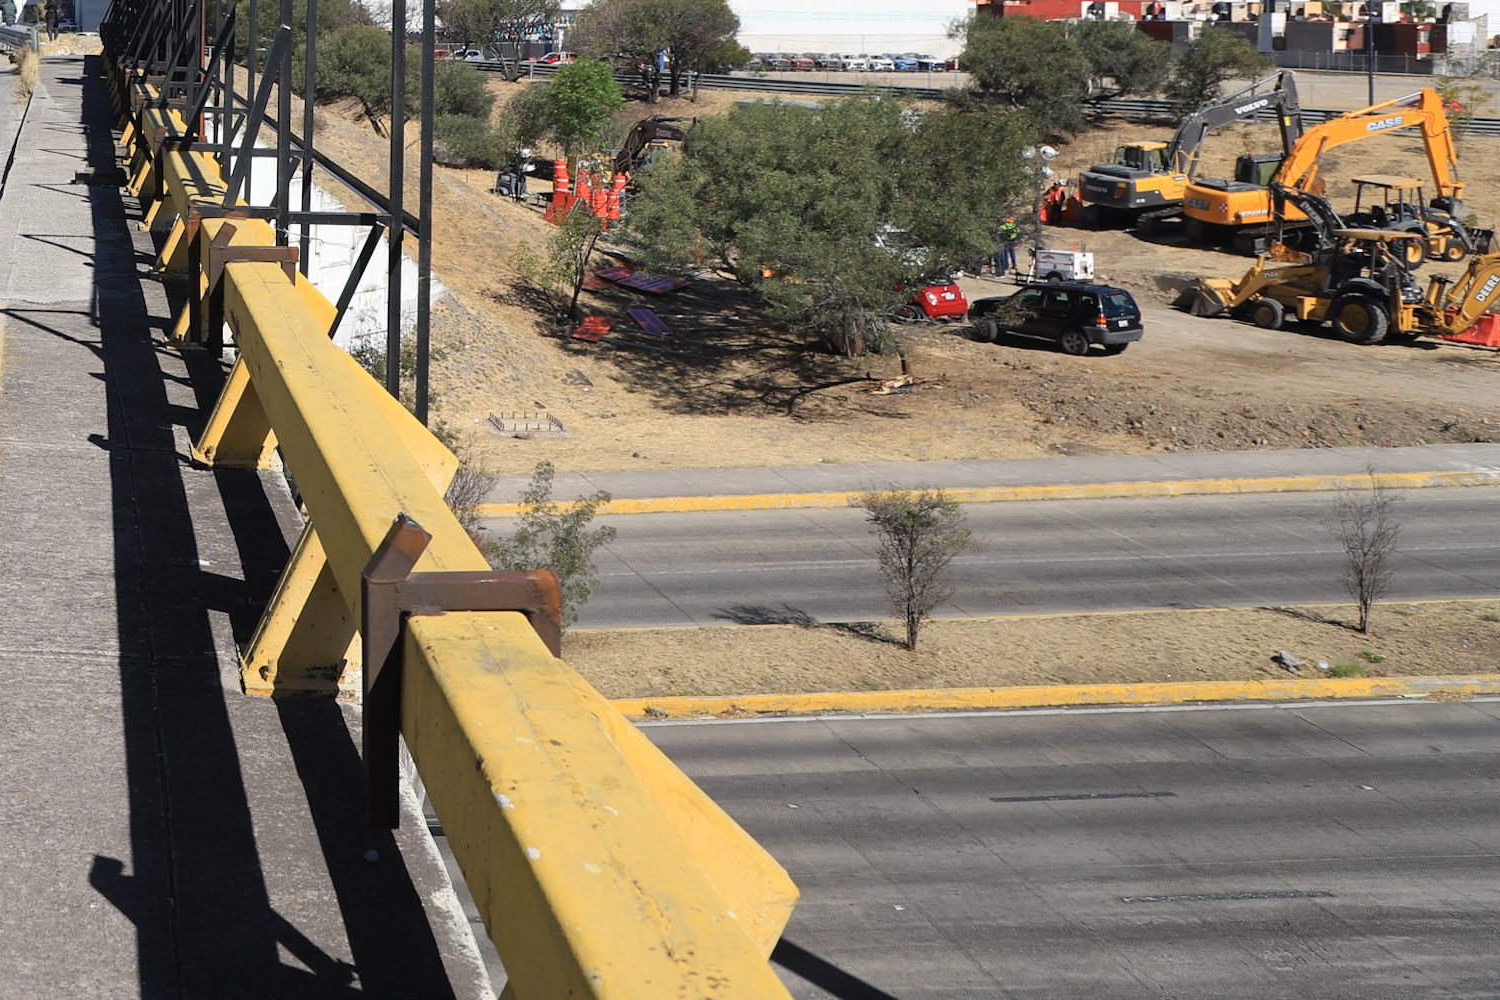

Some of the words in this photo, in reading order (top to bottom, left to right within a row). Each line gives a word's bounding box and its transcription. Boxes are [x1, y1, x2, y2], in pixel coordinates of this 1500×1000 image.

[1234, 99, 1268, 115] VOLVO
[1367, 116, 1404, 131] CASE
[1086, 184, 1108, 193] VOLVO
[1476, 274, 1500, 303] DEERE
